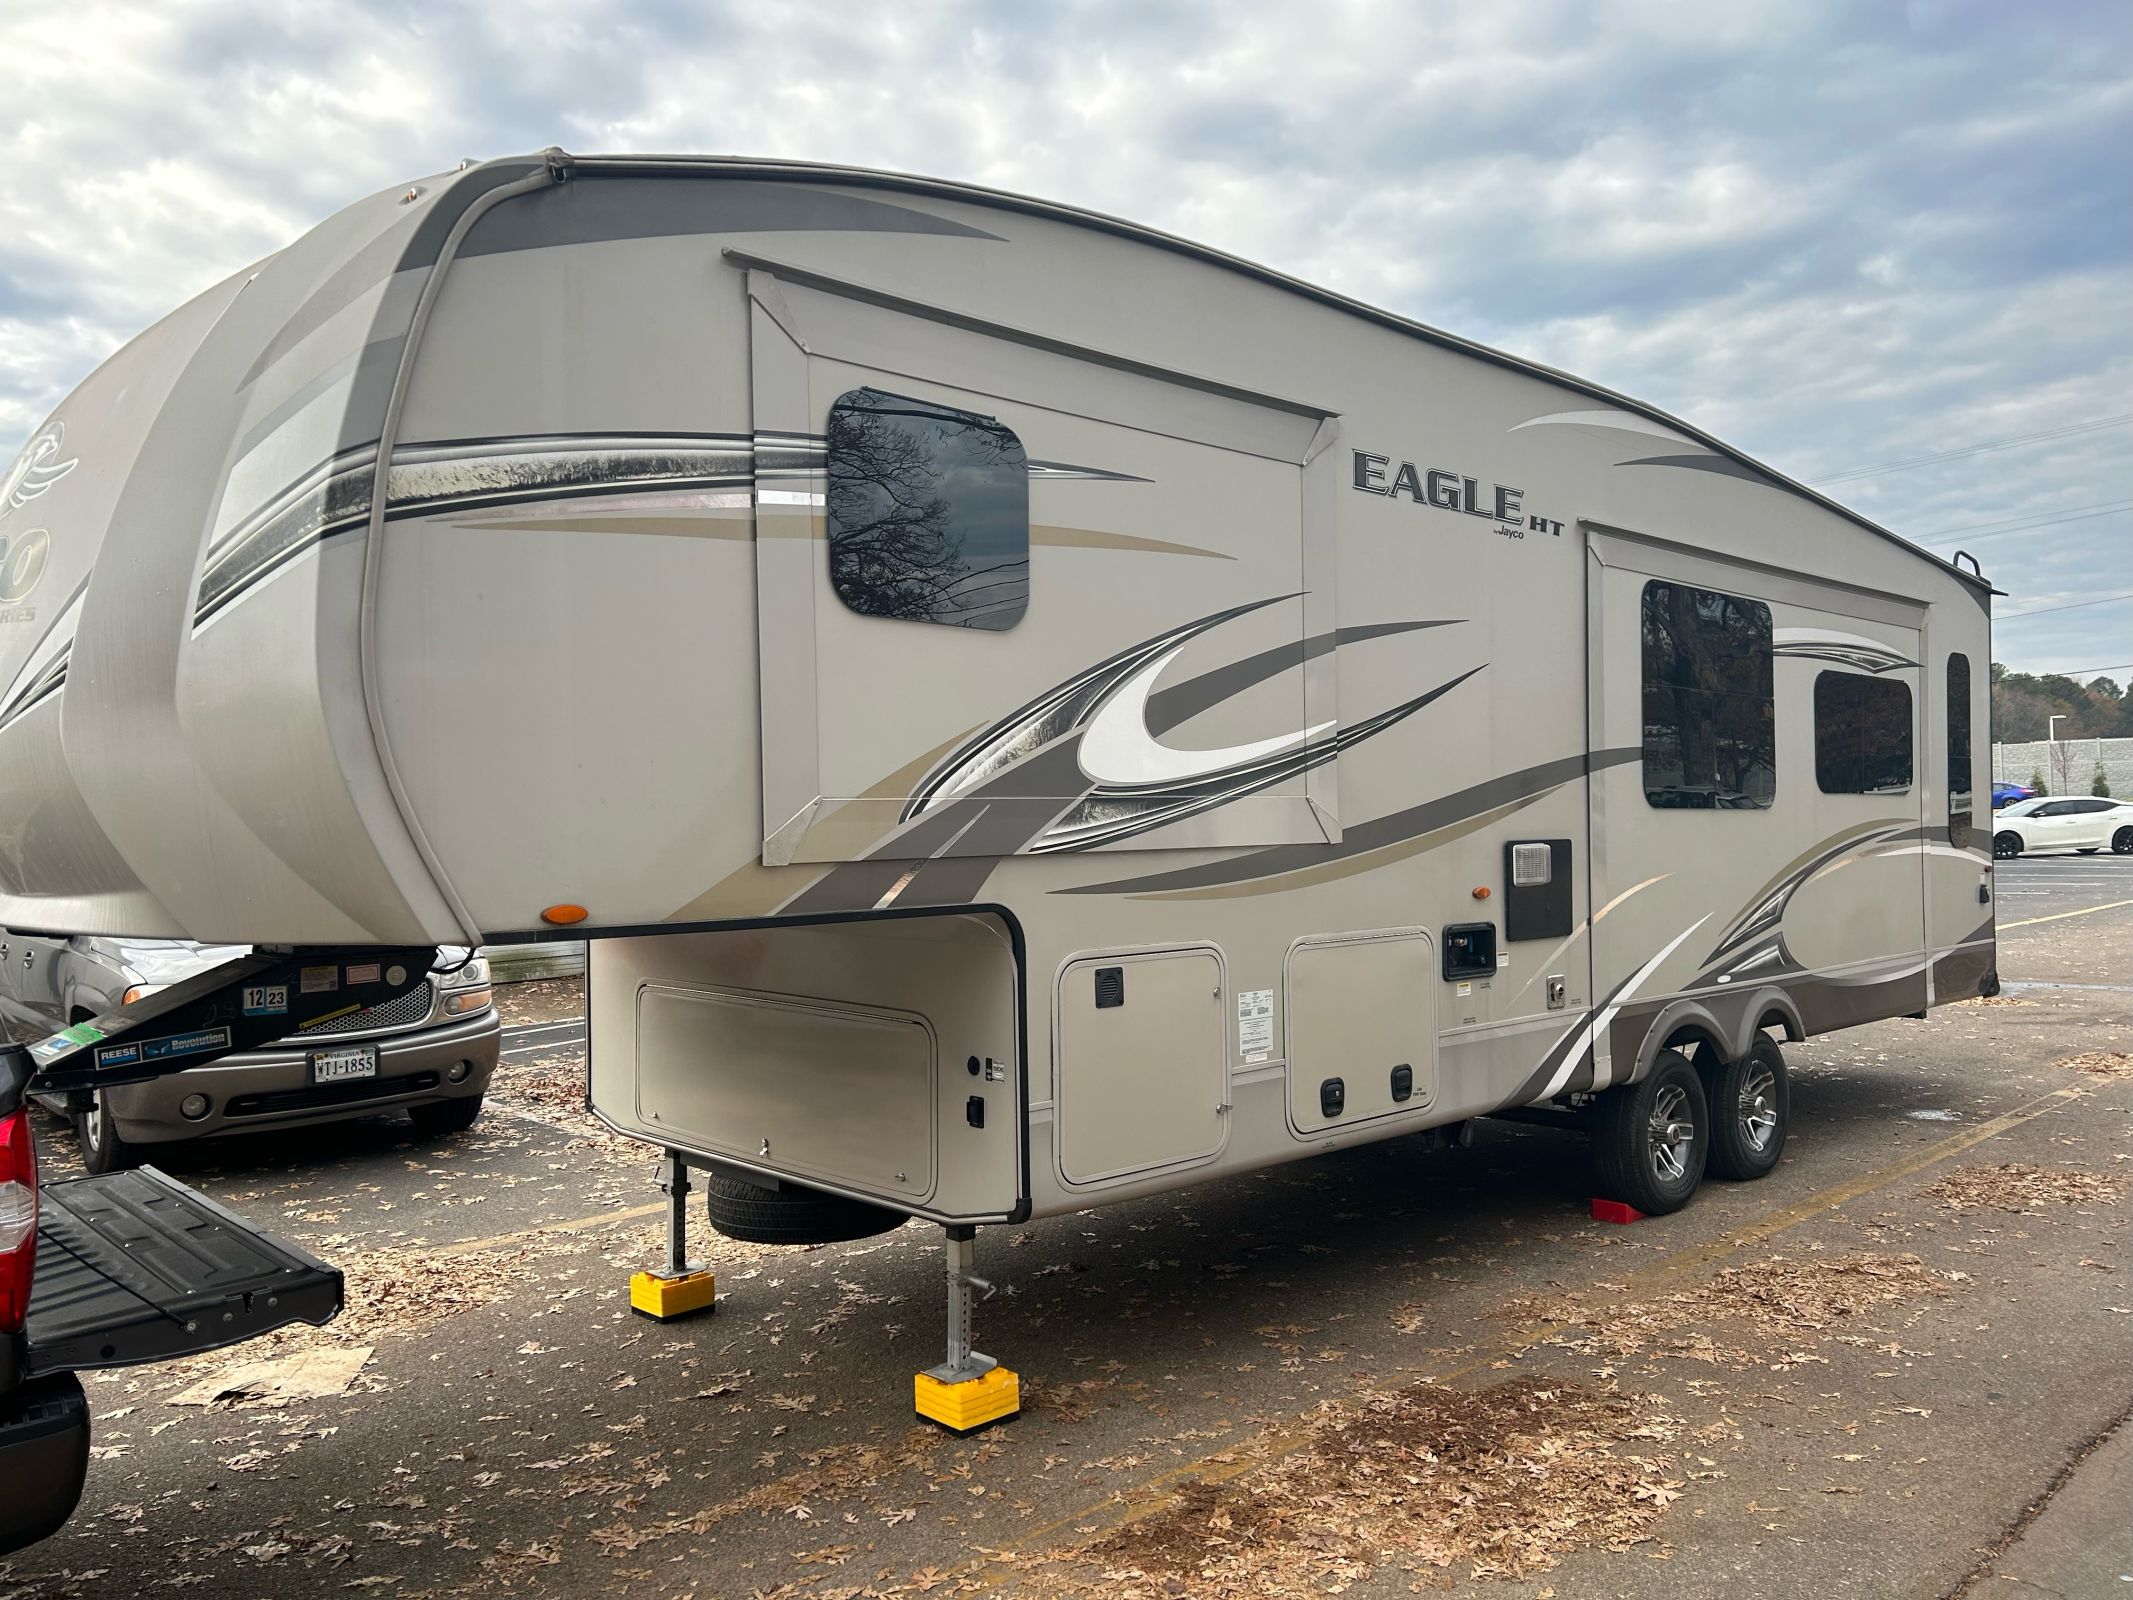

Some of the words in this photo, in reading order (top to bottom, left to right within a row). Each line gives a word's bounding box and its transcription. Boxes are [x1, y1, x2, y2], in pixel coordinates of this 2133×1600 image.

[1352, 448, 1524, 525] EAGLE
[1529, 515, 1565, 537] HT
[1499, 525, 1524, 539] Jayco
[249, 989, 263, 1007] 12
[268, 992, 285, 1005] 23
[101, 1046, 138, 1060] REESE
[171, 1033, 226, 1050] Revolution
[329, 1050, 360, 1059] VIRGINIA
[316, 1056, 374, 1076] WTJ-1855
